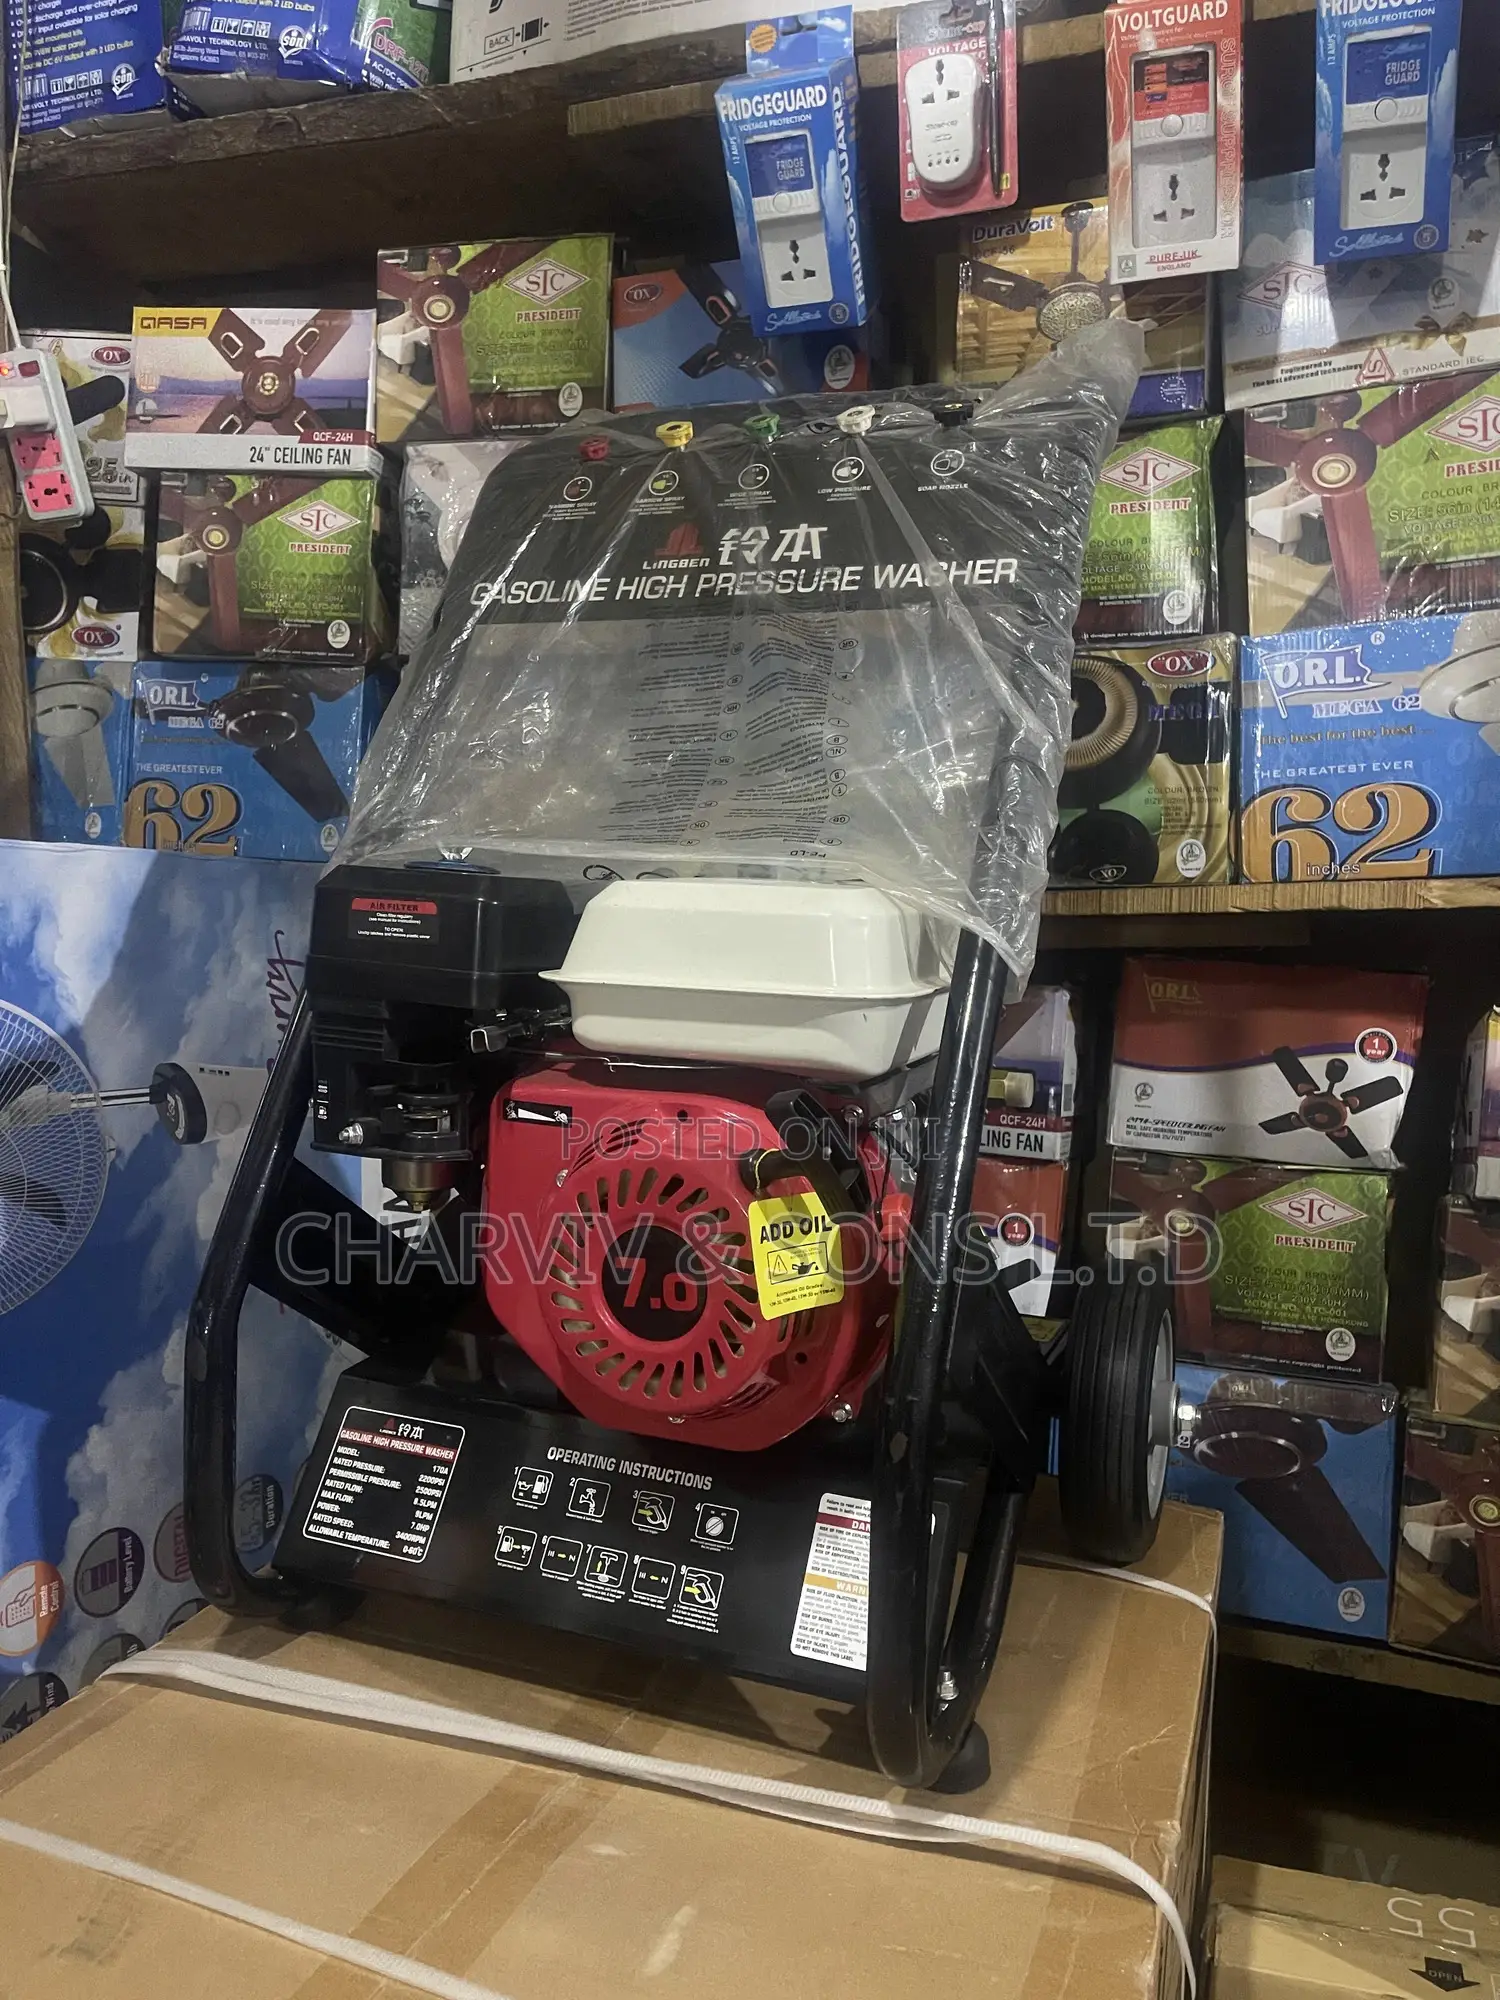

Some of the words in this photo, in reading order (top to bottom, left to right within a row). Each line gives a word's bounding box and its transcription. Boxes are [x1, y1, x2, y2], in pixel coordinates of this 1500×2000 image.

[280, 1, 293, 9] LED
[54, 17, 83, 29] available
[84, 14, 93, 23] for
[110, 4, 138, 17] charging
[1117, 0, 1228, 33] VOLTGUARD
[1342, 16, 1379, 28] VOLTAGE
[1381, 7, 1436, 22] PROTECTION
[208, 37, 252, 49] TECHNOLOGY
[488, 35, 511, 49] BACK
[1327, 33, 1336, 53] AMPS
[64, 51, 84, 62] output
[104, 44, 116, 52] LED
[1386, 59, 1421, 74] FRIDGE
[1384, 71, 1420, 86] GUARD
[50, 93, 89, 106] TECHNOLOGY
[720, 85, 828, 123] FRIDGEGUARD
[738, 120, 769, 132] VOLTAGE
[769, 113, 812, 127] PROTECTION
[776, 157, 804, 170] FRIDGE
[777, 168, 806, 181] GUARD
[832, 86, 866, 305] FRIDGEGUARD
[973, 215, 1054, 243] DuraVolt
[1149, 249, 1199, 263] PURE-UK
[1157, 262, 1191, 272] ENGLAND
[526, 268, 565, 297] STC
[516, 308, 581, 323] PRESIDENT
[1322, 360, 1333, 369] by
[1402, 359, 1461, 376] STANDARD
[1465, 355, 1485, 366] IEC
[1252, 379, 1265, 389] The
[1266, 375, 1282, 386] best
[1320, 363, 1363, 378] technology
[313, 431, 354, 443] QCF-24H
[273, 447, 322, 465] CEILING
[327, 448, 351, 466] FAN
[1121, 457, 1171, 493] STC
[834, 485, 872, 493] PRESSURE
[1422, 486, 1473, 500] COLOUR
[1110, 499, 1190, 514] PRESIDENT
[300, 509, 337, 532] STC
[1388, 506, 1433, 523] SIZE:
[291, 543, 350, 554] PRESIDENT
[1089, 538, 1133, 549] COLOUR
[470, 575, 610, 605] GASOLINE
[615, 571, 692, 599] HIGH
[694, 562, 863, 597] PRESSURE
[872, 557, 1019, 590] WASHER
[1273, 655, 1361, 688] O.R.L.
[150, 686, 195, 707] O.R.L.
[1313, 698, 1383, 719] MEGA
[1392, 695, 1421, 711] 62
[168, 716, 204, 728] MEGA
[208, 717, 224, 729] 62
[1290, 731, 1323, 744] best
[1326, 730, 1347, 741] for
[1352, 727, 1376, 739] the
[136, 763, 151, 773] THE
[153, 764, 198, 775] GREATEST
[200, 765, 223, 775] EVER
[1255, 766, 1281, 779] THE
[1286, 763, 1367, 779] GREATEST
[1372, 760, 1414, 773] EVER
[124, 777, 244, 857] 62
[1240, 780, 1444, 883] 62
[1306, 863, 1360, 877] inches
[370, 902, 385, 910] AIR
[1372, 1038, 1379, 1049] 1
[1366, 1048, 1386, 1057] year
[1000, 1114, 1046, 1129] QCF-24H
[1016, 1132, 1044, 1153] FAN
[1287, 1197, 1336, 1226] STC
[760, 1221, 794, 1244] ADD
[799, 1215, 833, 1236] OIL
[1275, 1234, 1355, 1253] PRESIDENT
[1253, 1266, 1297, 1278] COLOUR
[614, 1257, 701, 1311] 7.0
[337, 1446, 360, 1457] MODEL:
[341, 1429, 372, 1444] GASOLINE
[373, 1436, 389, 1447] HIGH
[390, 1440, 425, 1453] PRESSURE
[425, 1446, 455, 1460] WASHER
[333, 1457, 352, 1466] RATED
[353, 1460, 385, 1474] PRESSURE:
[432, 1465, 448, 1475] 170A
[514, 1467, 519, 1475] 1
[546, 1446, 616, 1472] OPERATING
[618, 1458, 713, 1491] INSTRUCTIONS
[325, 1479, 343, 1490] RATED
[344, 1483, 364, 1494] FLOW:
[329, 1468, 368, 1482] PERMISSIBLE
[368, 1475, 402, 1490] PRESSURE:
[418, 1474, 446, 1486] 2200PSI
[569, 1477, 576, 1487] 2
[320, 1490, 335, 1499] MAX
[335, 1493, 354, 1504] FLOW:
[415, 1486, 443, 1498] 2500PSI
[632, 1490, 639, 1499] 3
[265, 1484, 276, 1529] Duration
[317, 1501, 340, 1513] POWER:
[413, 1498, 438, 1510] 8.5LPM
[695, 1502, 701, 1511] 4
[312, 1513, 332, 1524] RATED
[332, 1517, 355, 1528] SPEED:
[410, 1521, 430, 1532] 7.0HP
[308, 1524, 344, 1539] ALLOWABLE
[344, 1531, 391, 1549] TEMPERATURE:
[497, 1525, 503, 1534] 5
[395, 1531, 427, 1544] 3400RPM
[541, 1535, 548, 1545] 6
[124, 1536, 133, 1560] Level
[586, 1544, 592, 1553] 7
[633, 1554, 640, 1565] 8
[124, 1559, 135, 1594] Battery
[680, 1565, 687, 1575] 9
[39, 1585, 48, 1618] Remote
[51, 1580, 60, 1614] Control
[1428, 1969, 1463, 1983] OPEN
